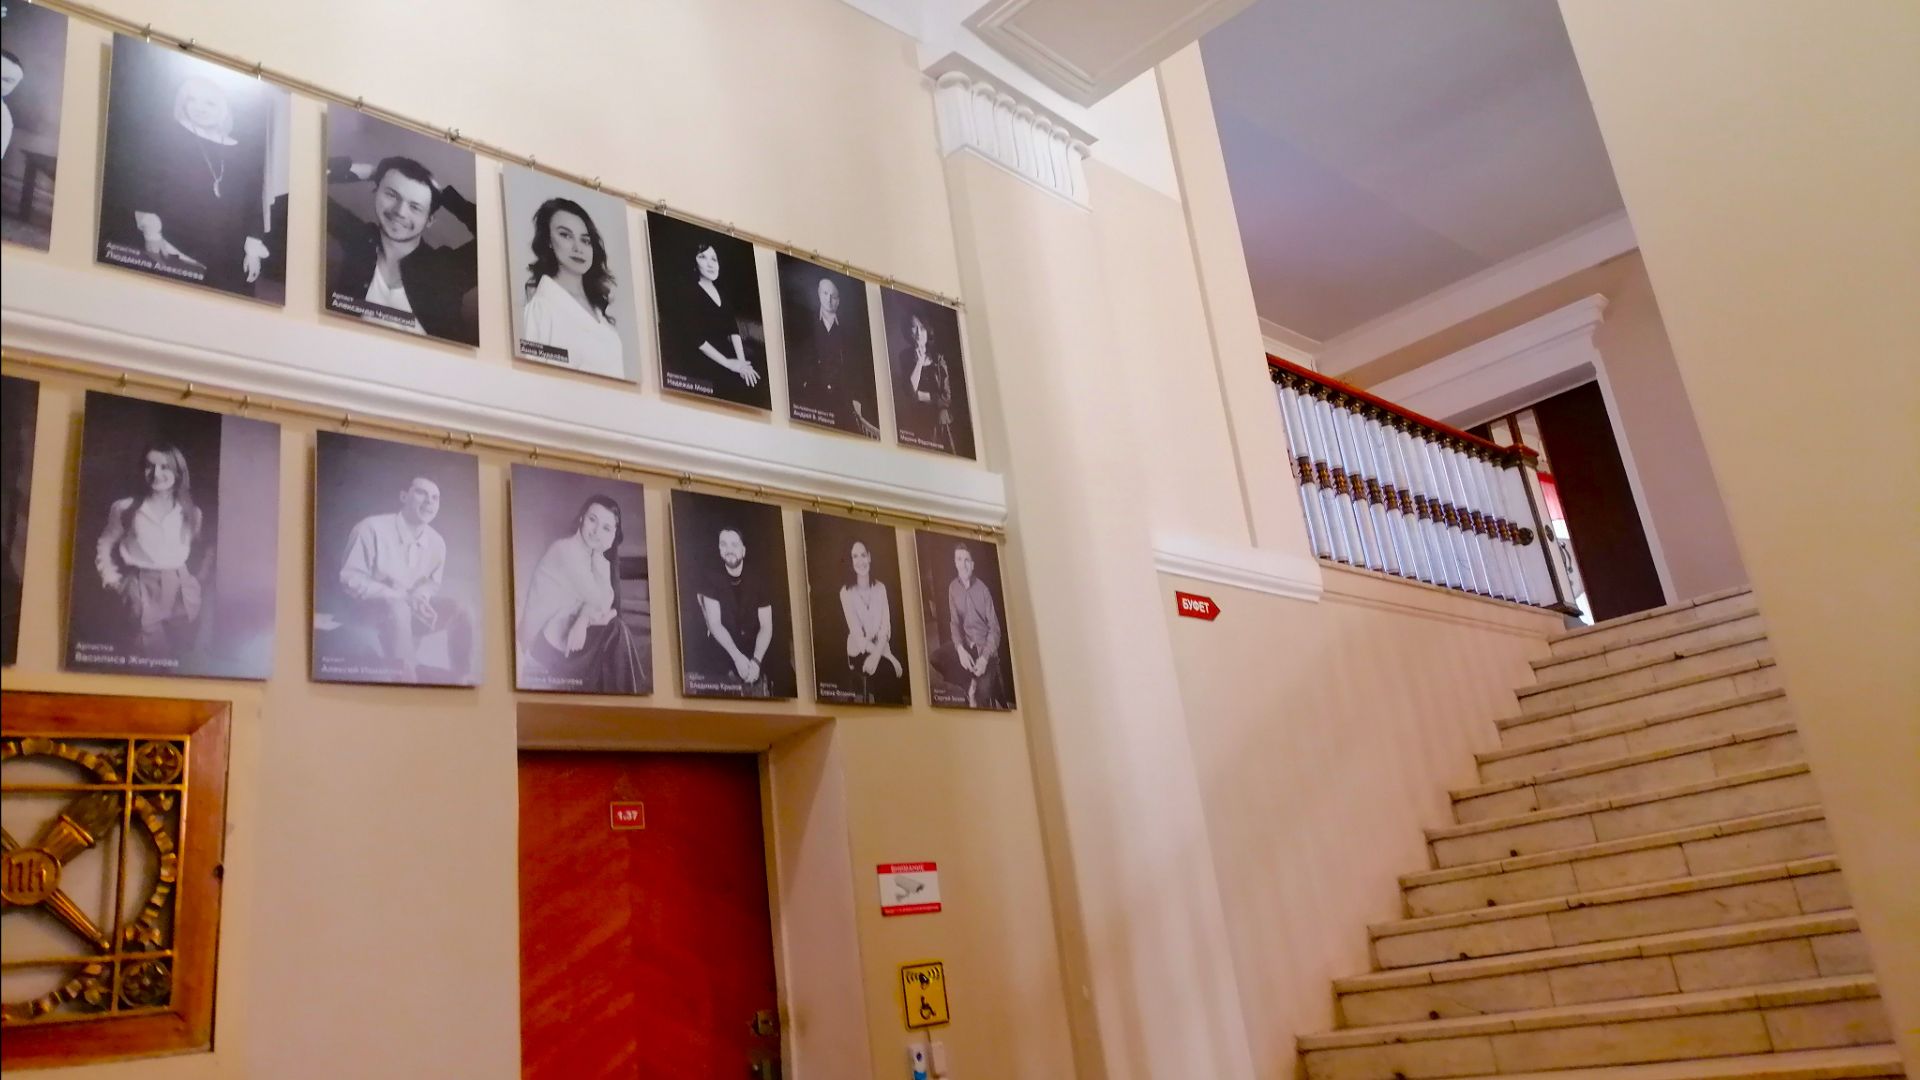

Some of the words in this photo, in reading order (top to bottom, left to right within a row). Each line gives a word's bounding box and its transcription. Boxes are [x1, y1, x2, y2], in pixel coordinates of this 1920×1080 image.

[105, 250, 153, 268] Людмила
[154, 261, 204, 280] Алексеева
[332, 299, 375, 316] Александр
[667, 378, 693, 389] Надежда
[1182, 597, 1209, 614] БУФЕТ
[75, 651, 125, 664] Василиса
